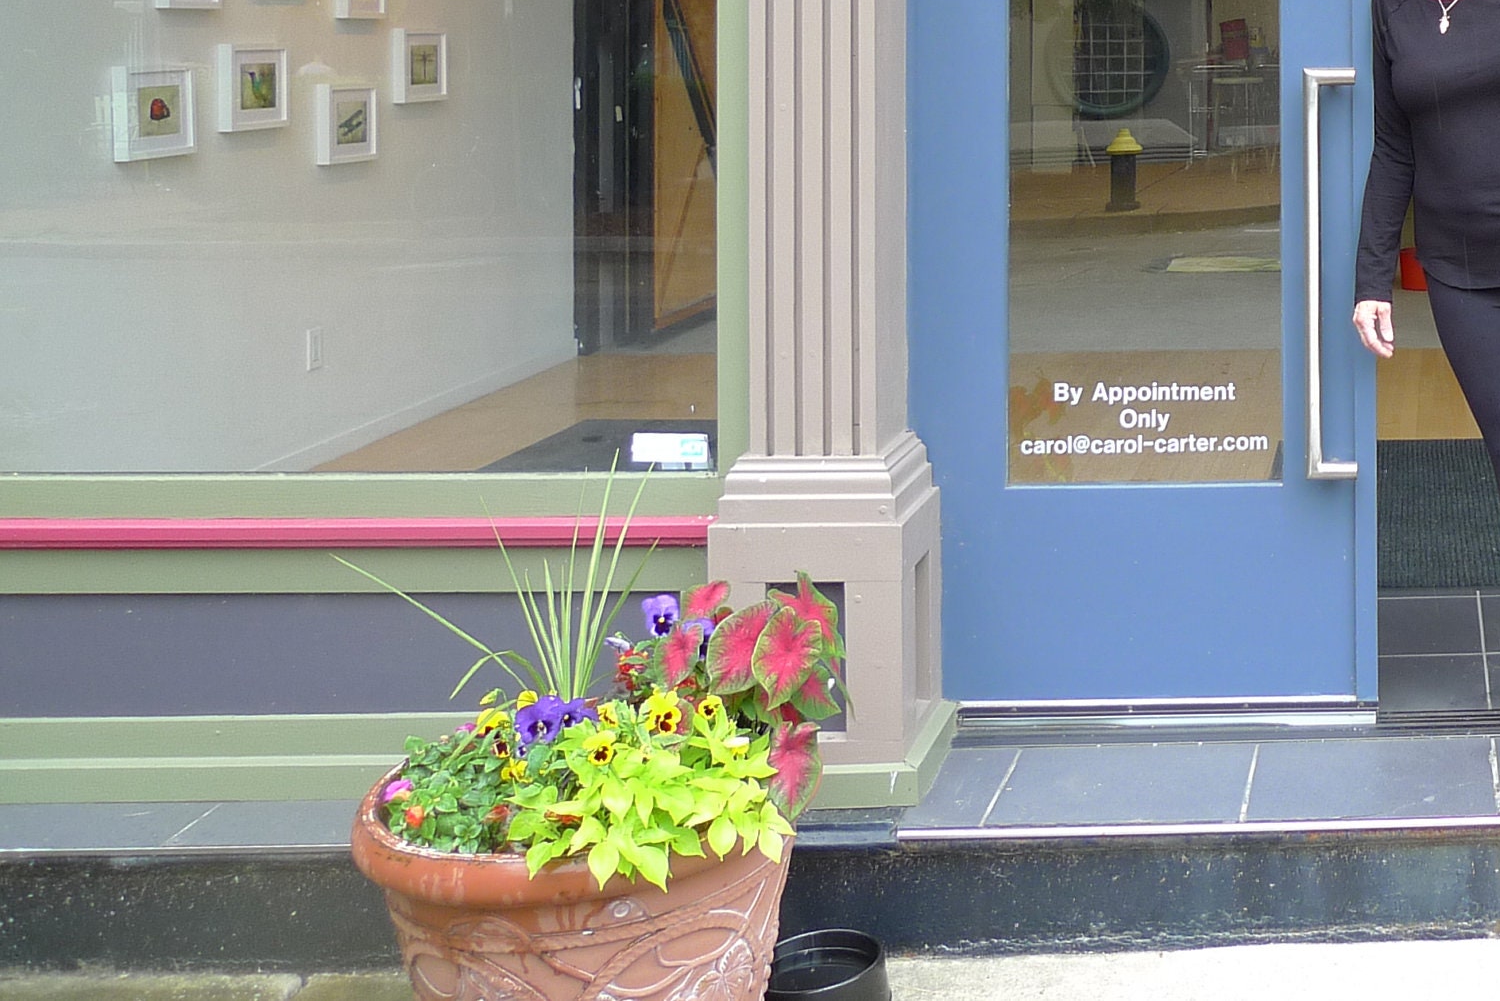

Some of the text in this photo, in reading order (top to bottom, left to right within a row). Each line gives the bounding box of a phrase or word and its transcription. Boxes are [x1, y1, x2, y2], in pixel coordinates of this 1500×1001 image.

[1054, 382, 1236, 405] By Appointment
[1119, 409, 1170, 431] Only
[1020, 434, 1268, 455] carol@carol-carter.com
